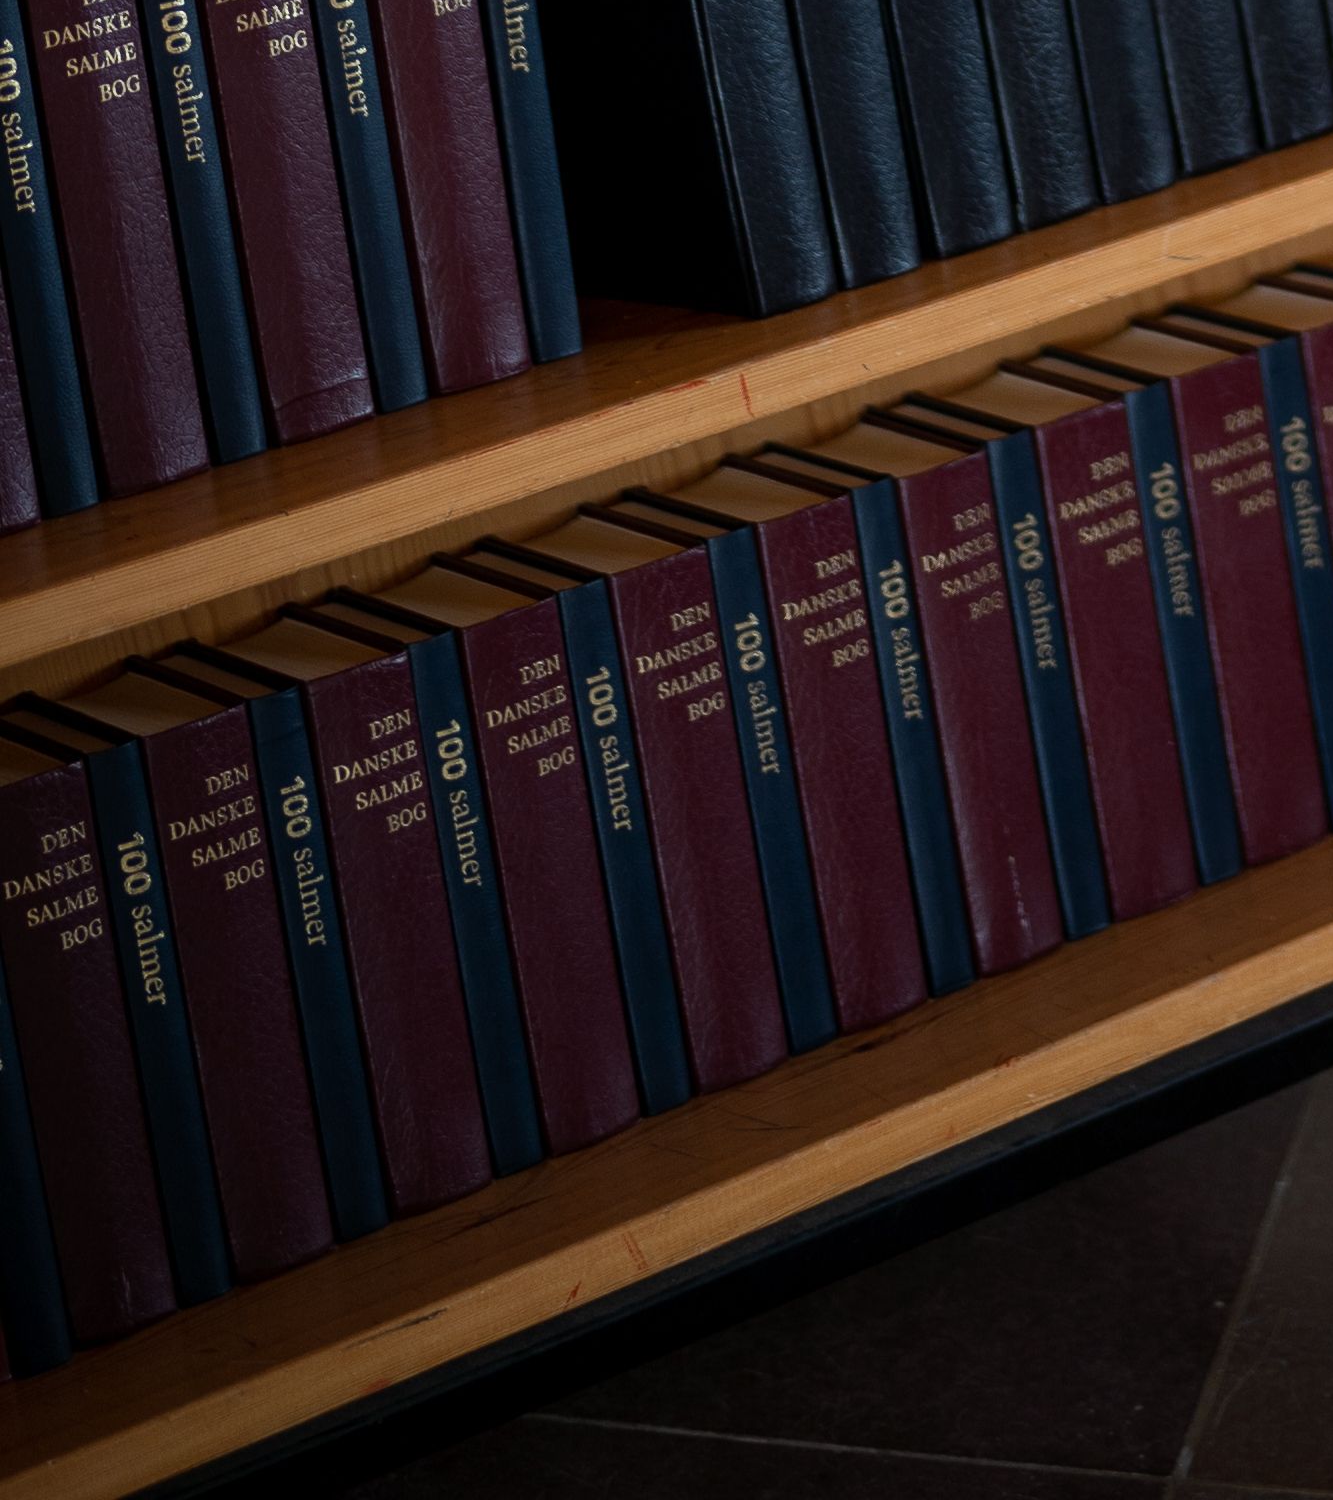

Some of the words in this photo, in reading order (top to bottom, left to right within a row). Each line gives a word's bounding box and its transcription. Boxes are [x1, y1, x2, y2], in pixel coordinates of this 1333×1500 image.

[44, 10, 132, 49] DANSKE
[236, 0, 304, 33] SALME
[66, 43, 137, 77] SALME
[269, 31, 308, 57] BOG
[0, 39, 21, 101] 100
[100, 74, 141, 102] BOG
[337, 18, 369, 117] salmer
[174, 65, 205, 164] salmer
[2, 112, 36, 213] salmer
[670, 602, 711, 631] DEN
[636, 632, 717, 674] DANSKE
[734, 613, 766, 674] 100
[519, 654, 561, 684] DEN
[657, 662, 722, 700] SALME
[486, 685, 567, 729] DANSKE
[585, 666, 618, 728] 100
[687, 692, 726, 721] BOG
[369, 708, 412, 739] DEN
[507, 716, 571, 754] SALME
[748, 681, 779, 775] salmer
[333, 739, 419, 783] DANSKE
[436, 720, 467, 781] 100
[537, 746, 576, 776] BOG
[205, 764, 250, 795] DEN
[356, 770, 423, 810] SALME
[600, 736, 632, 832] salmer
[169, 796, 256, 840] DANSKE
[280, 776, 312, 839] 100
[388, 802, 427, 833] BOG
[42, 821, 86, 854] DEN
[192, 827, 261, 867] SALME
[449, 789, 482, 887] salmer
[4, 854, 93, 899] DANSKE
[117, 832, 152, 896] 100
[224, 859, 266, 890] BOG
[27, 886, 99, 927] SALME
[294, 848, 326, 946] salmer
[60, 918, 103, 951] BOG
[132, 906, 167, 1006] salmer
